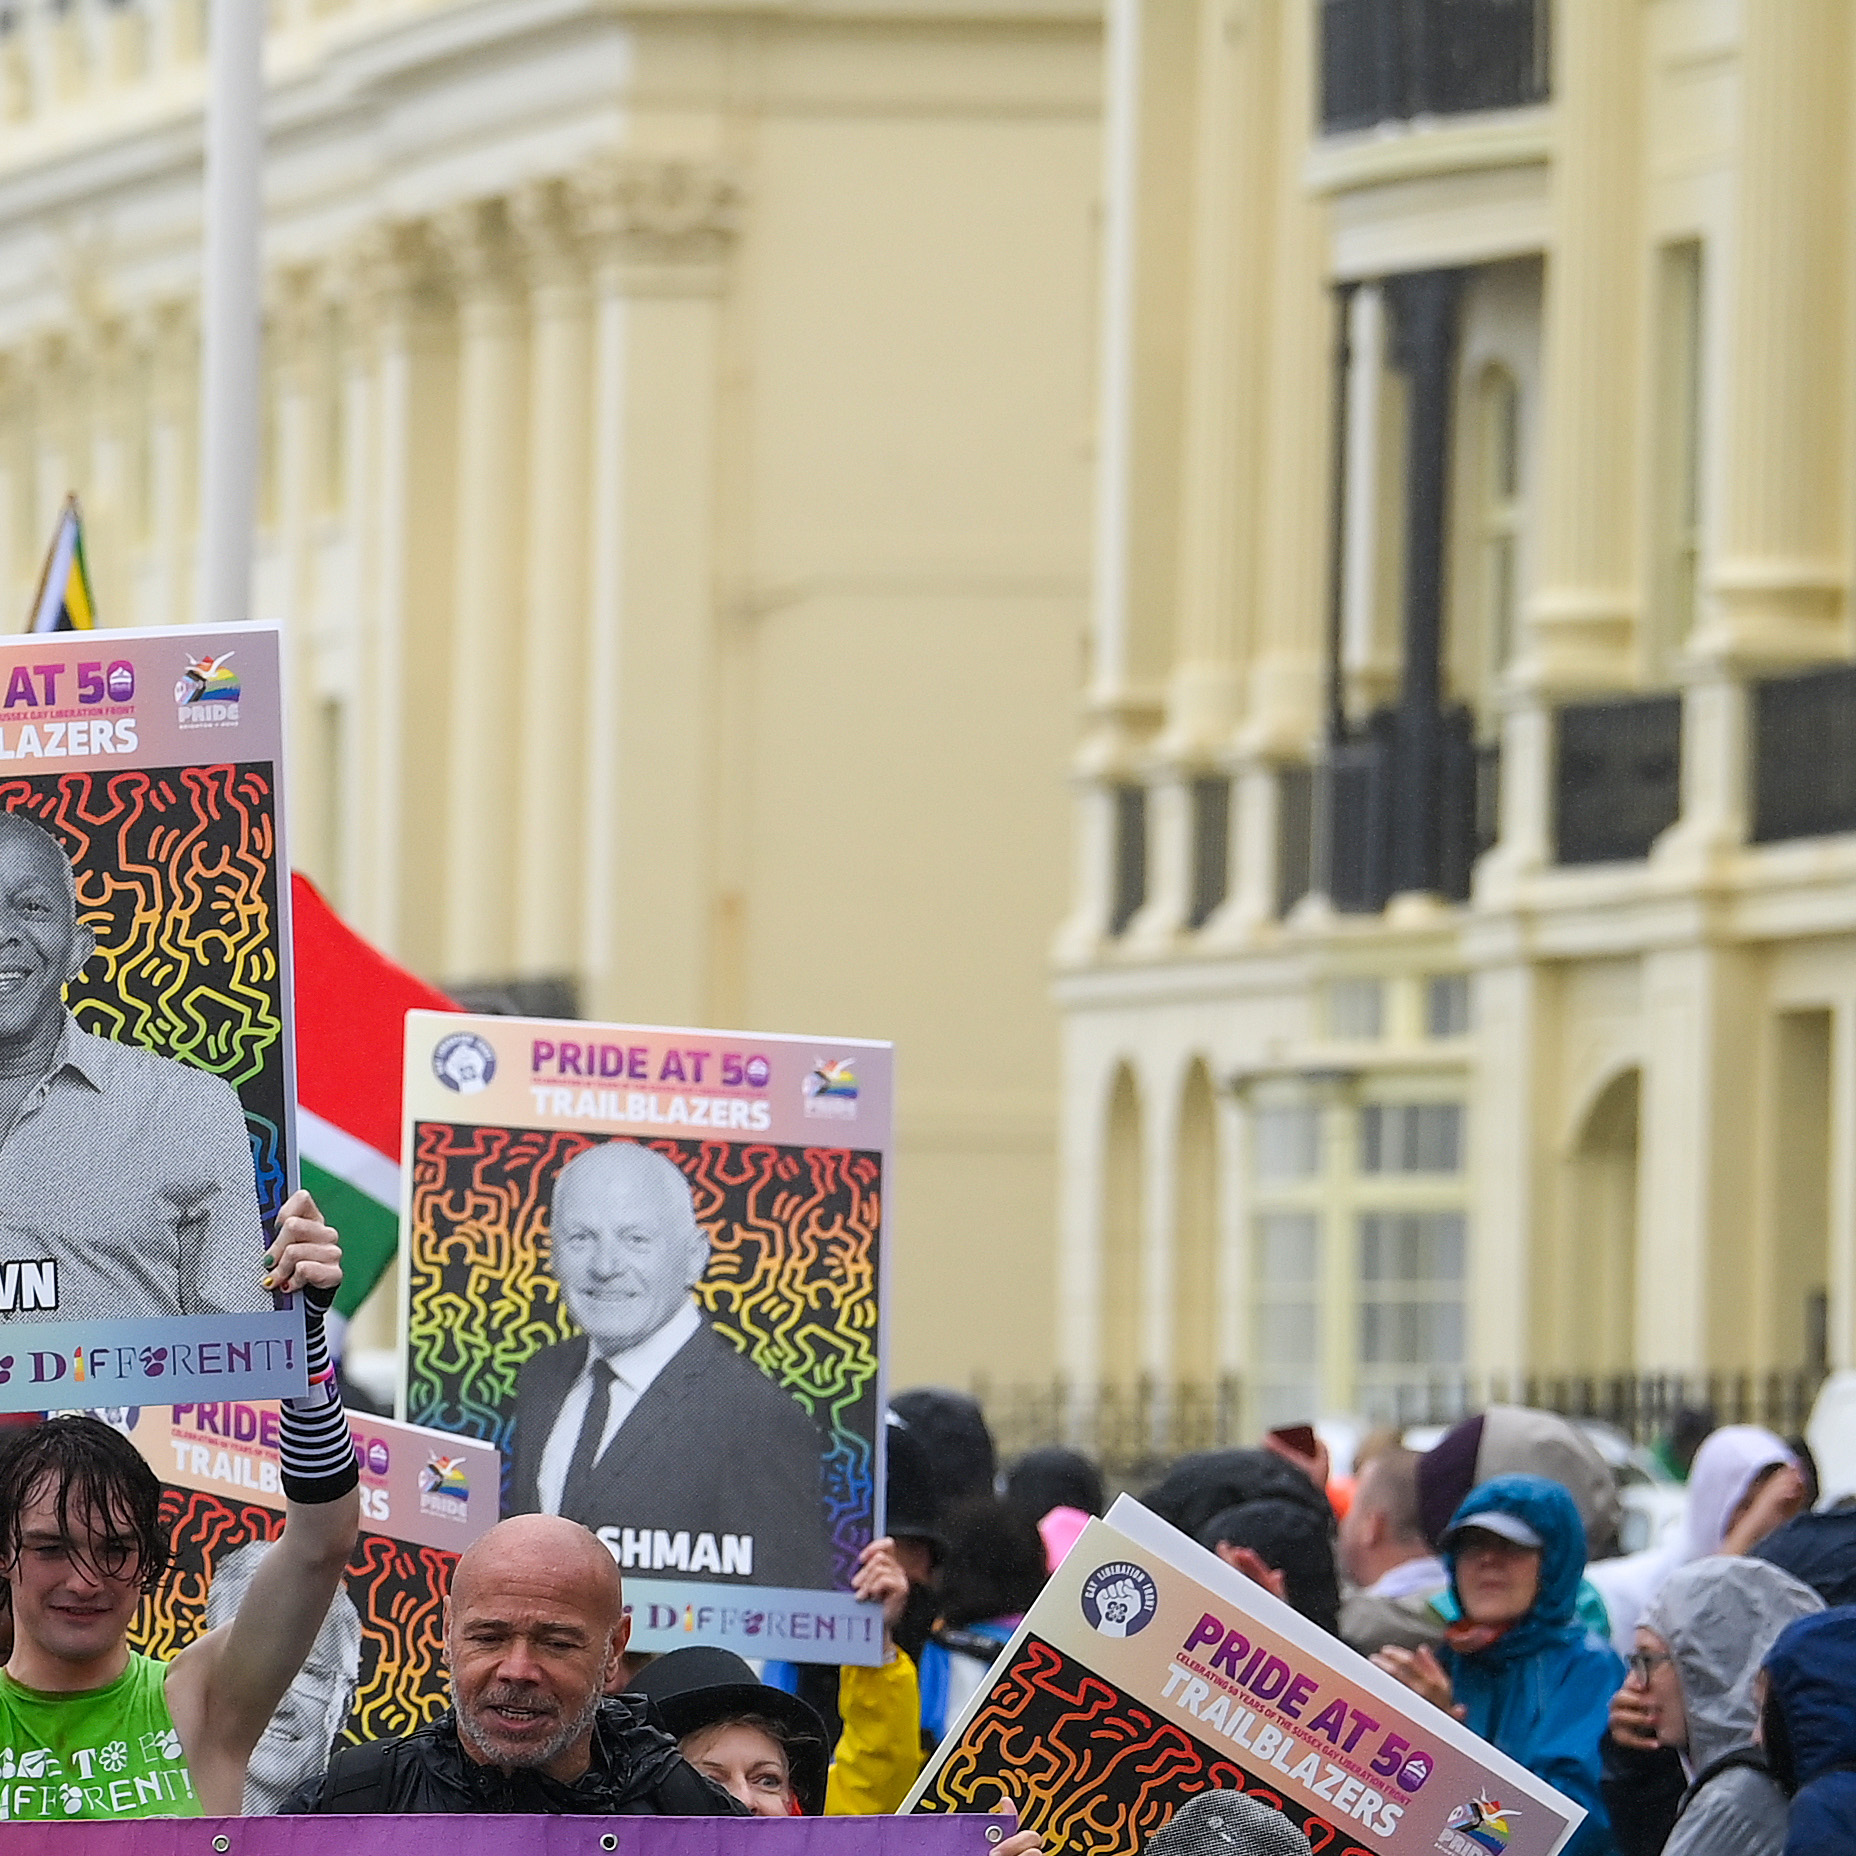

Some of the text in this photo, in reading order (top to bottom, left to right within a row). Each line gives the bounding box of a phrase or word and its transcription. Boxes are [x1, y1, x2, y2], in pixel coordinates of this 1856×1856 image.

[3, 665, 61, 708] AT
[77, 660, 135, 704] 50
[530, 1086, 771, 1132] TRAILBLAZERS
[531, 1039, 648, 1080] PRIDE
[659, 1051, 710, 1084] AT
[722, 1054, 770, 1087] 50
[1161, 1663, 1404, 1837] TRAILBLAZERS
[1176, 1652, 1229, 1691] CELEBRATING
[1239, 1689, 1264, 1713] YEARS
[1264, 1708, 1276, 1720] OF
[1277, 1715, 1292, 1731] THE
[1292, 1726, 1322, 1750] SUSSEX
[1322, 1746, 1340, 1760] GAY
[1339, 1755, 1384, 1789] LIBERATION
[1384, 1784, 1411, 1806] FRONT
[1183, 1612, 1434, 1792] PRIDE AT 50
